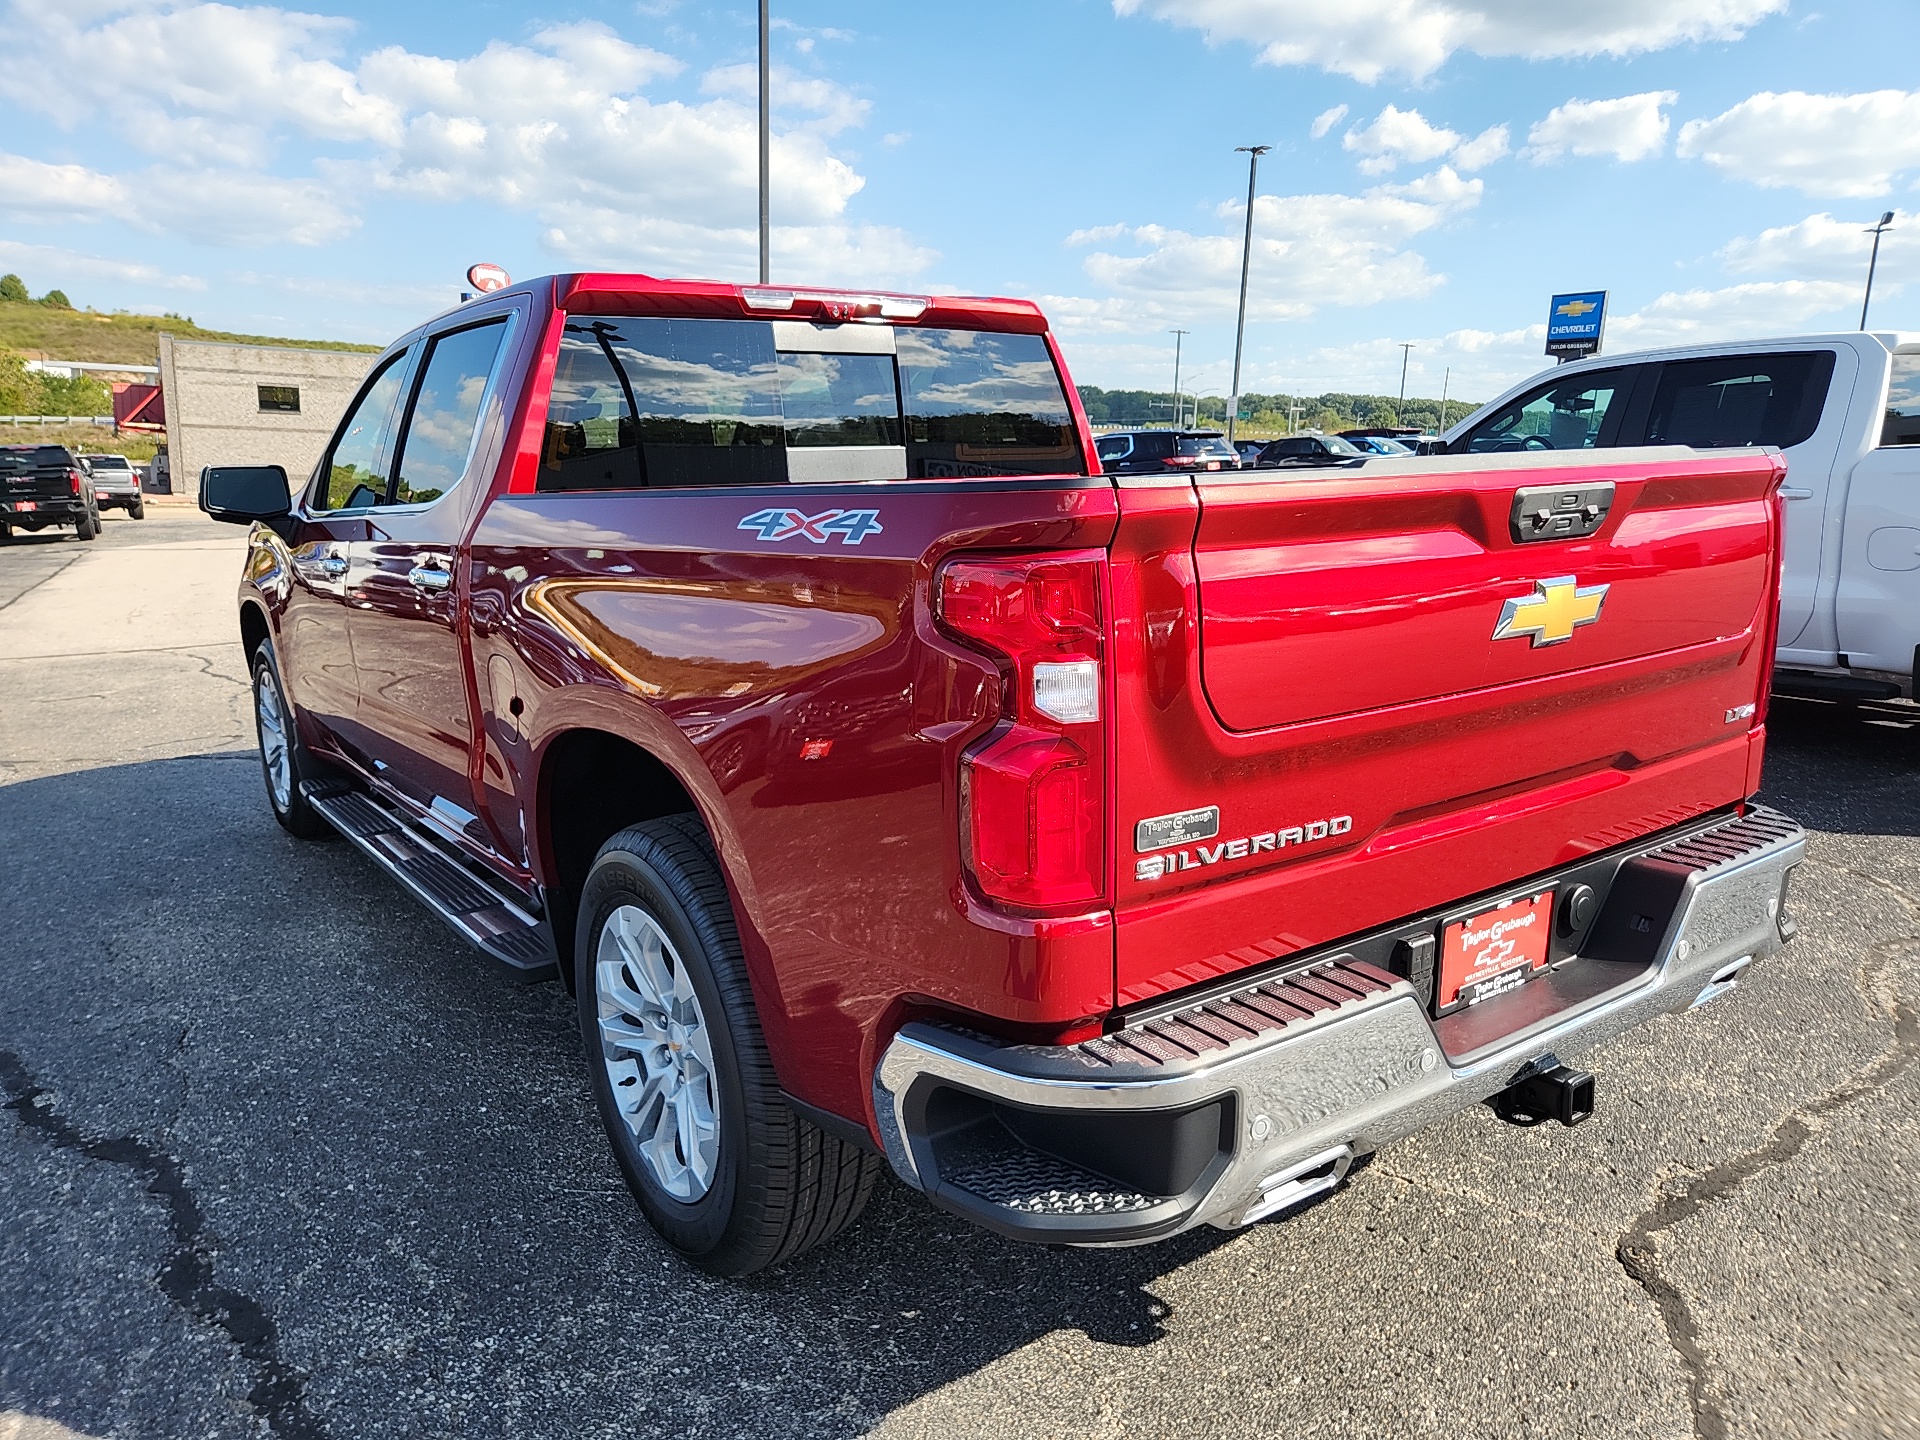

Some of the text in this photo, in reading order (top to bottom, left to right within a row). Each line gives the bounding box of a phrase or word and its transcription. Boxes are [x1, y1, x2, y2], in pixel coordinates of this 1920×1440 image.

[1551, 324, 1596, 334] CHEVROLET
[1145, 811, 1213, 836] Taylor Grubaugh
[1135, 815, 1352, 880] SILVERADO
[1461, 912, 1536, 951] Taylor Grubaugh
[1474, 980, 1493, 997] Taylor
